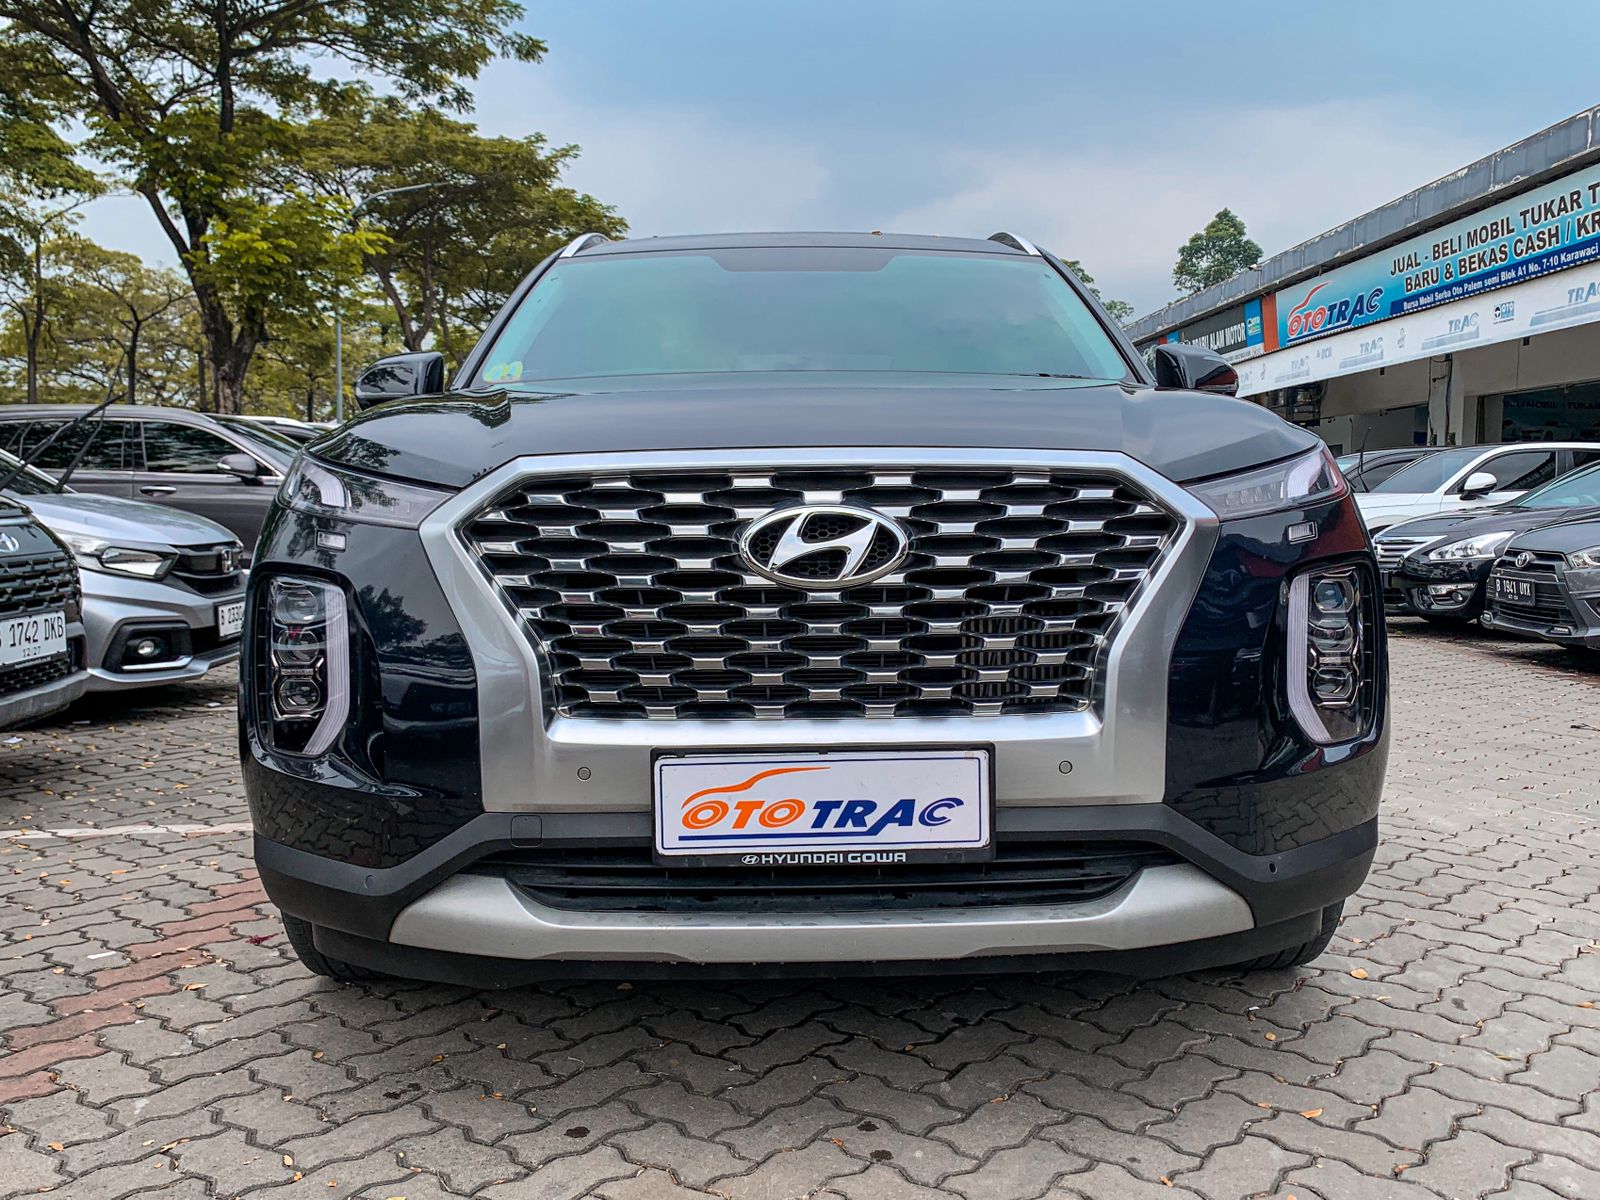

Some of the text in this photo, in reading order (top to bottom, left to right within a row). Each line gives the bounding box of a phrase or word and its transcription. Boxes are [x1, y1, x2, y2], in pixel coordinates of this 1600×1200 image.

[1390, 251, 1421, 276] JUAL
[1432, 235, 1462, 262] BELI
[1466, 217, 1515, 249] MOBIL
[1520, 189, 1582, 229] TUKAR
[1405, 267, 1440, 293] BARU
[1444, 263, 1454, 280] &
[1458, 245, 1509, 276] BEKAS
[1513, 224, 1560, 257] CASH
[1565, 220, 1571, 242] /
[1403, 242, 1599, 311] Bursa Mobil Serba Oto Palem semi Blok A1 No. 7-10 Karawaci
[1224, 322, 1247, 347] MOTOR
[9, 616, 64, 648] 1742 DKB
[761, 852, 907, 864] HYUNDAI GOWA
